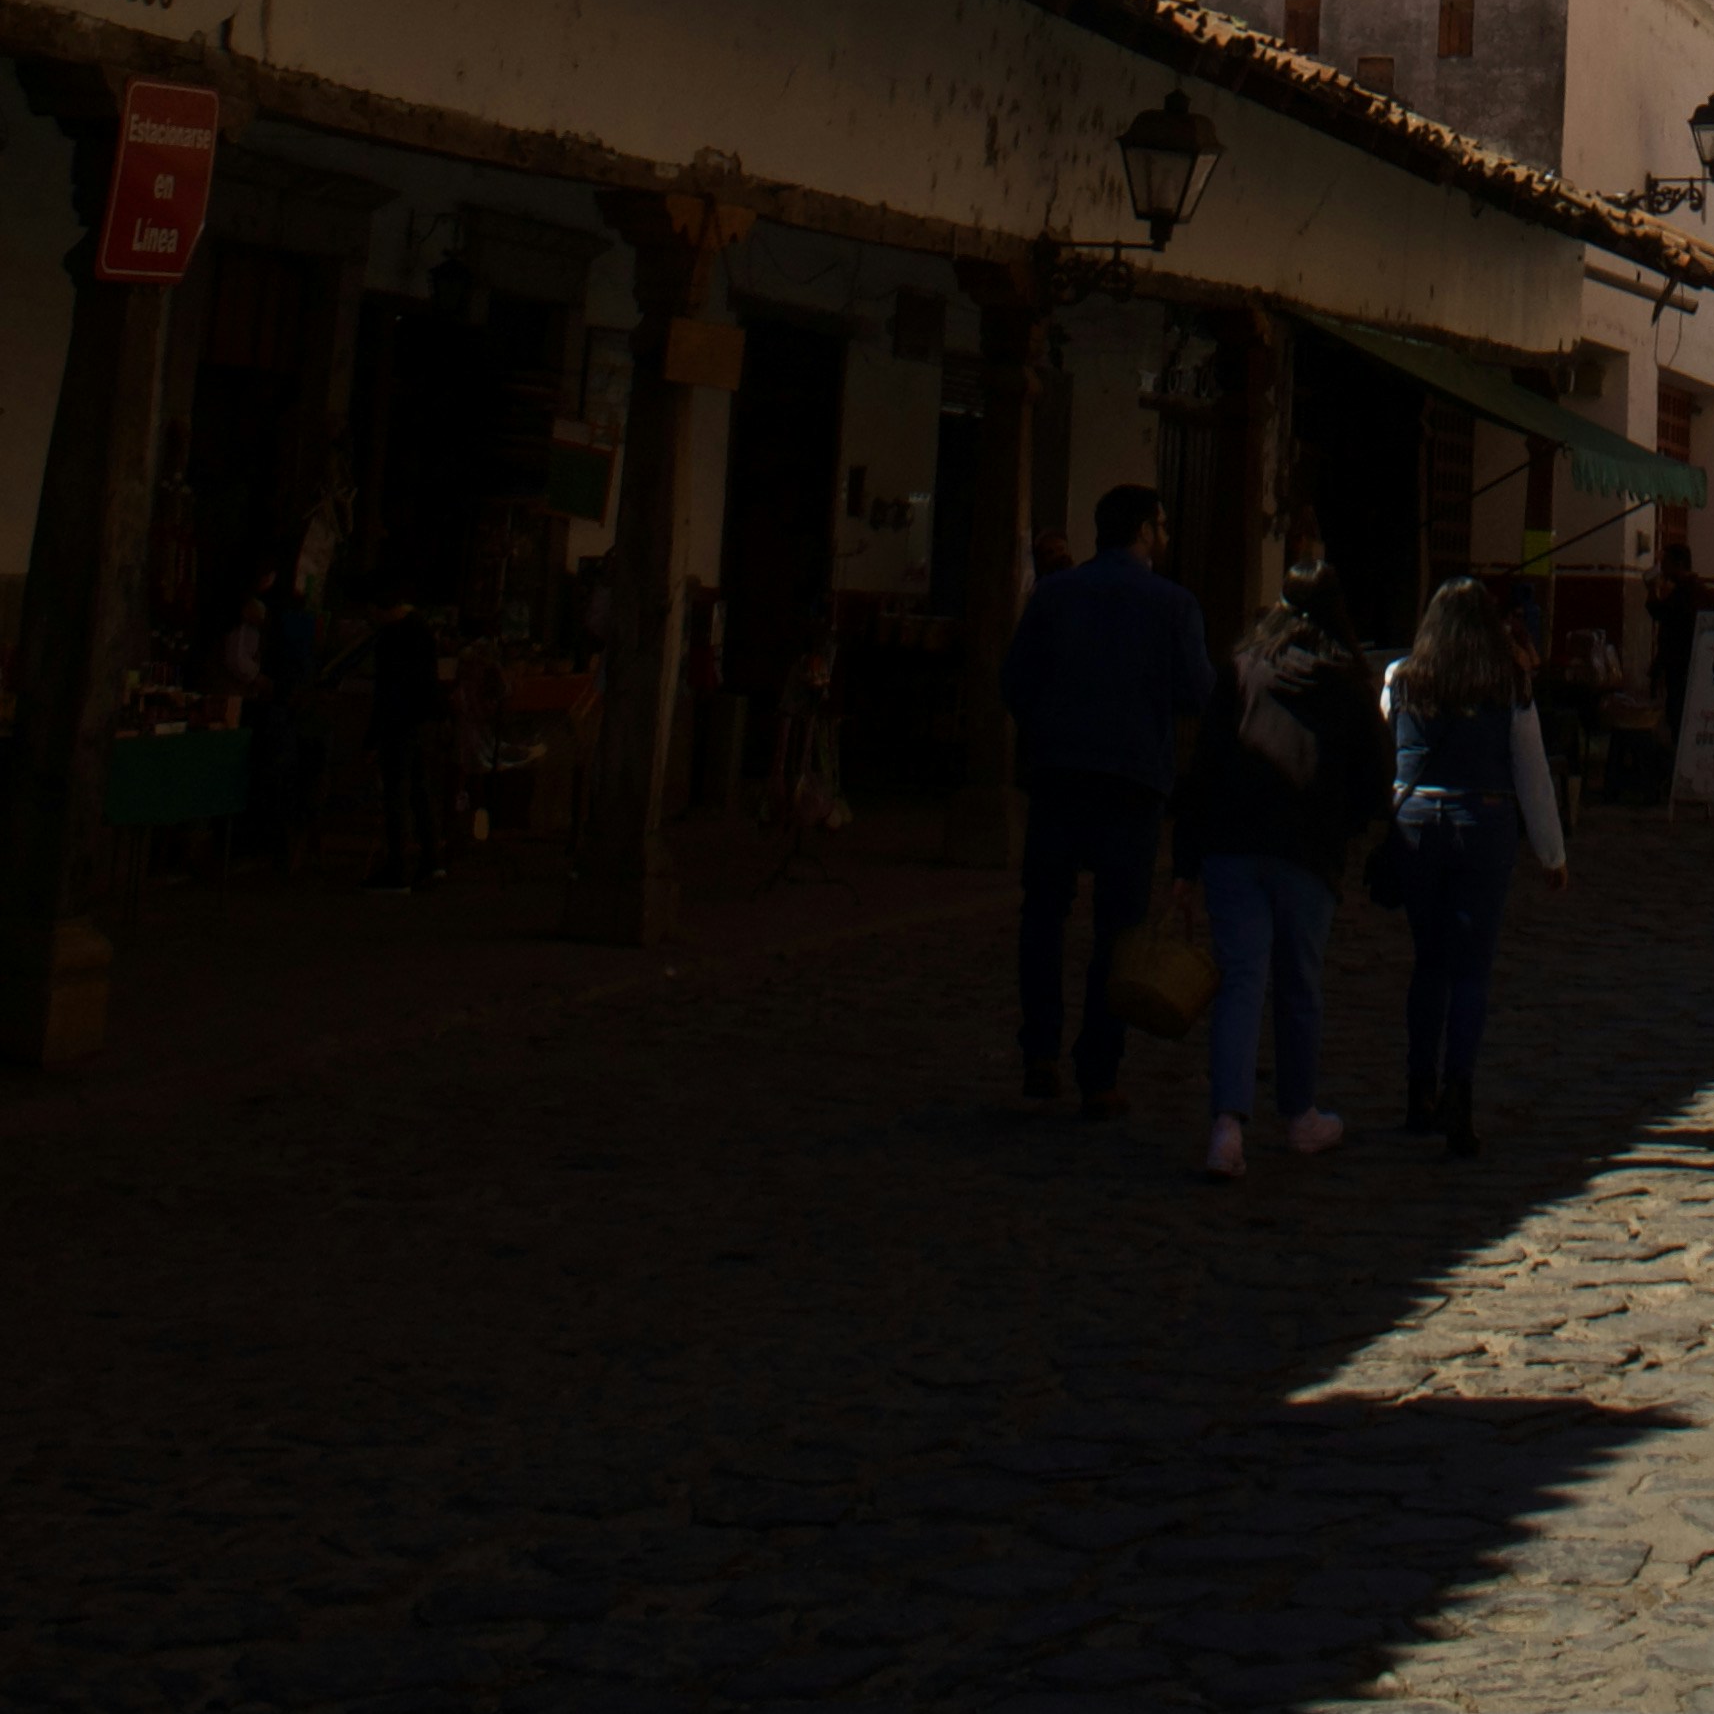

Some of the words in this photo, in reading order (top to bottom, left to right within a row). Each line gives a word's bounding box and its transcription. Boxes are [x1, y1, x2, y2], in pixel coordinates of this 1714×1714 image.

[128, 113, 213, 149] Estacionarse
[154, 173, 175, 200] en
[131, 217, 179, 253] Línea
